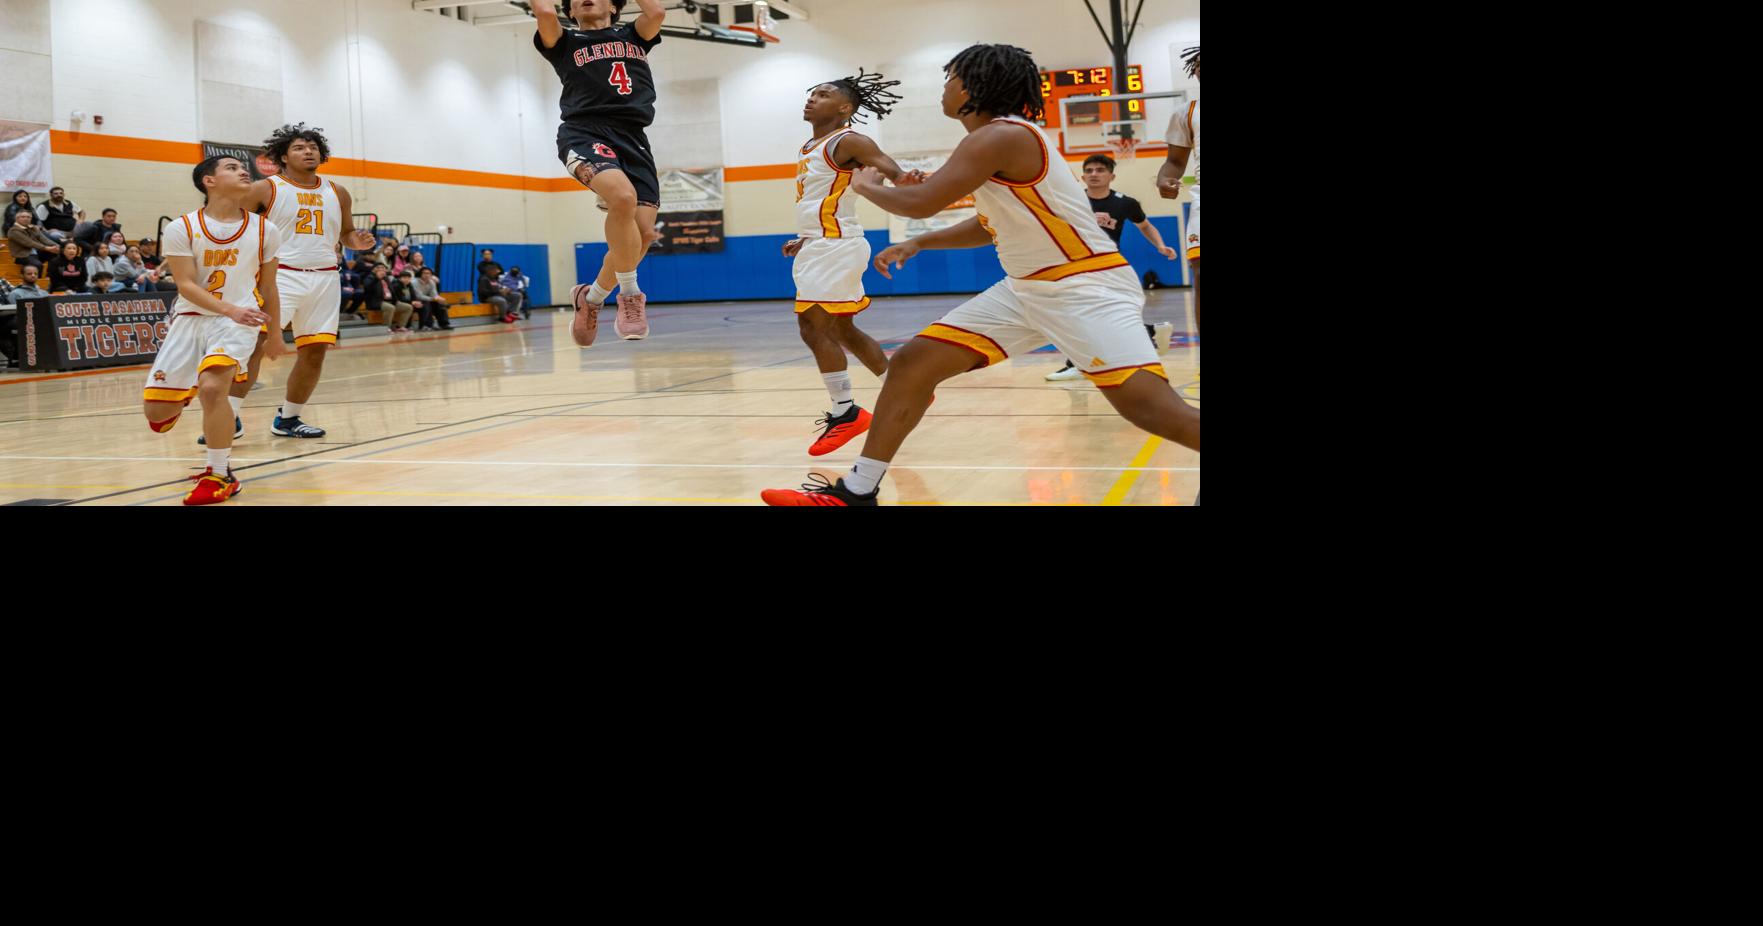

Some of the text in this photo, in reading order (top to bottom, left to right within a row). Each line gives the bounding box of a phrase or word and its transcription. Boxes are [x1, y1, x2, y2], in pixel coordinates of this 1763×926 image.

[573, 41, 648, 67] GLENDAL
[608, 61, 632, 95] 4
[1066, 68, 1107, 85] 7:12
[1127, 74, 1142, 91] 6
[1128, 99, 1140, 112] 0
[296, 192, 324, 207] DONS
[295, 208, 324, 236] 21
[203, 248, 240, 267] DONS
[207, 269, 227, 301] 2
[54, 298, 168, 318] SOUTH PASADENA
[66, 315, 161, 325] MIDDLE SCHOOL
